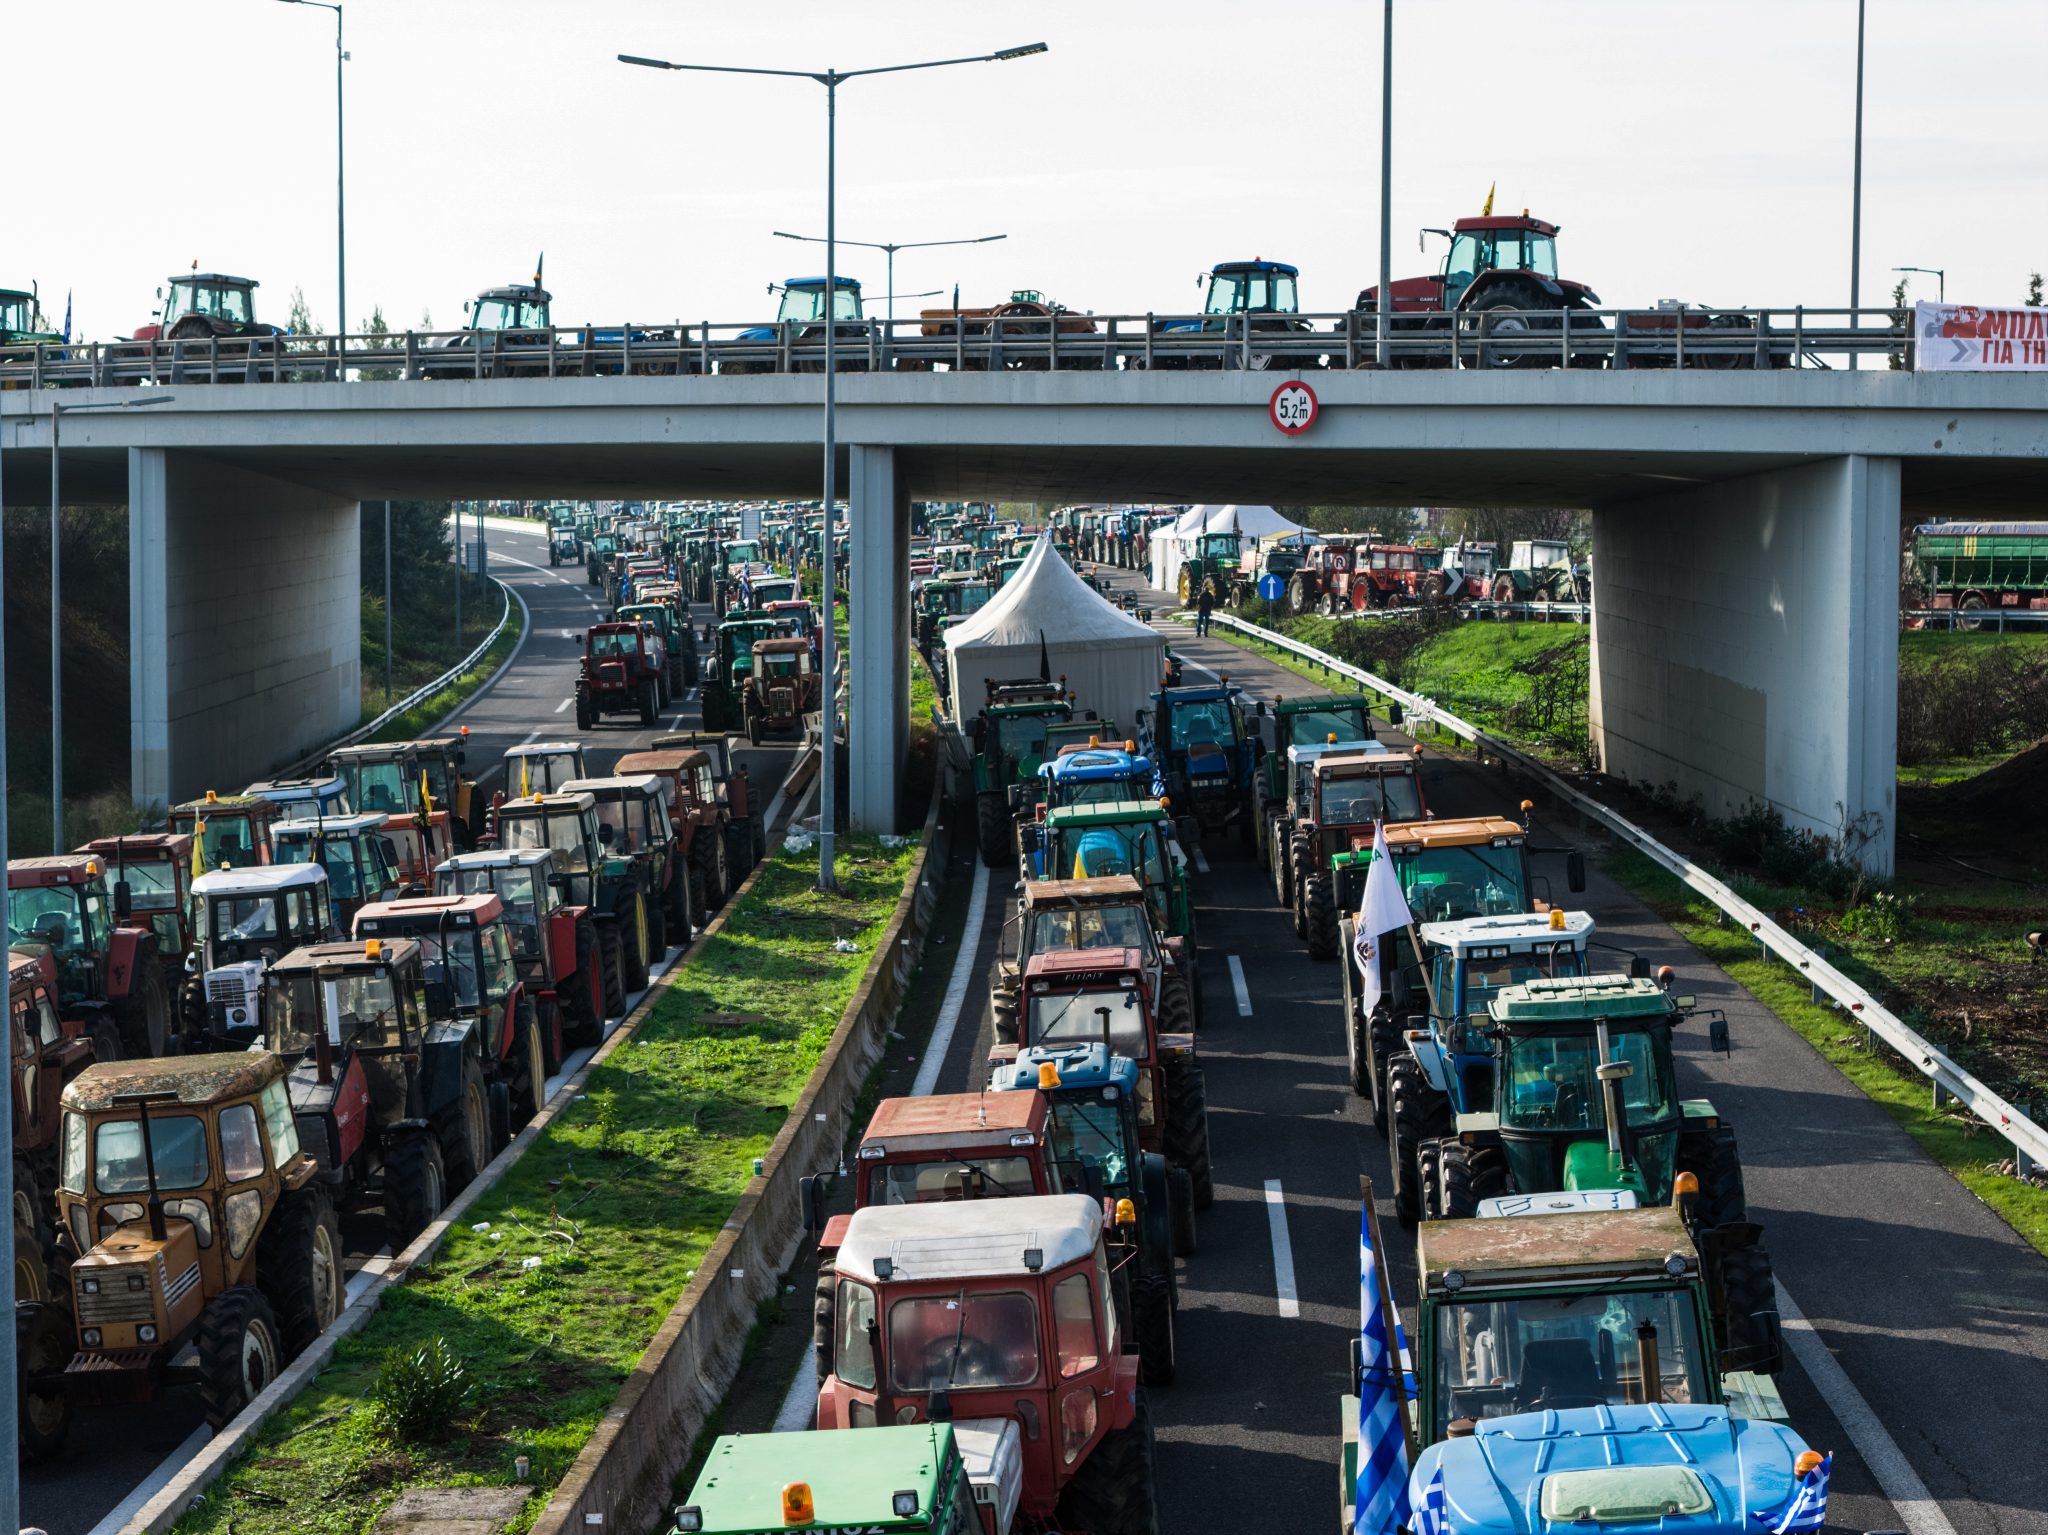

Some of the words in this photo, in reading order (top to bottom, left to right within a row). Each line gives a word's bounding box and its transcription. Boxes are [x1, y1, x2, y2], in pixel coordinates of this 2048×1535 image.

[1984, 311, 2048, 339] ΜΠΛ
[1983, 341, 2014, 364] ΓΙΑ
[2021, 341, 2046, 364] ΤΗ
